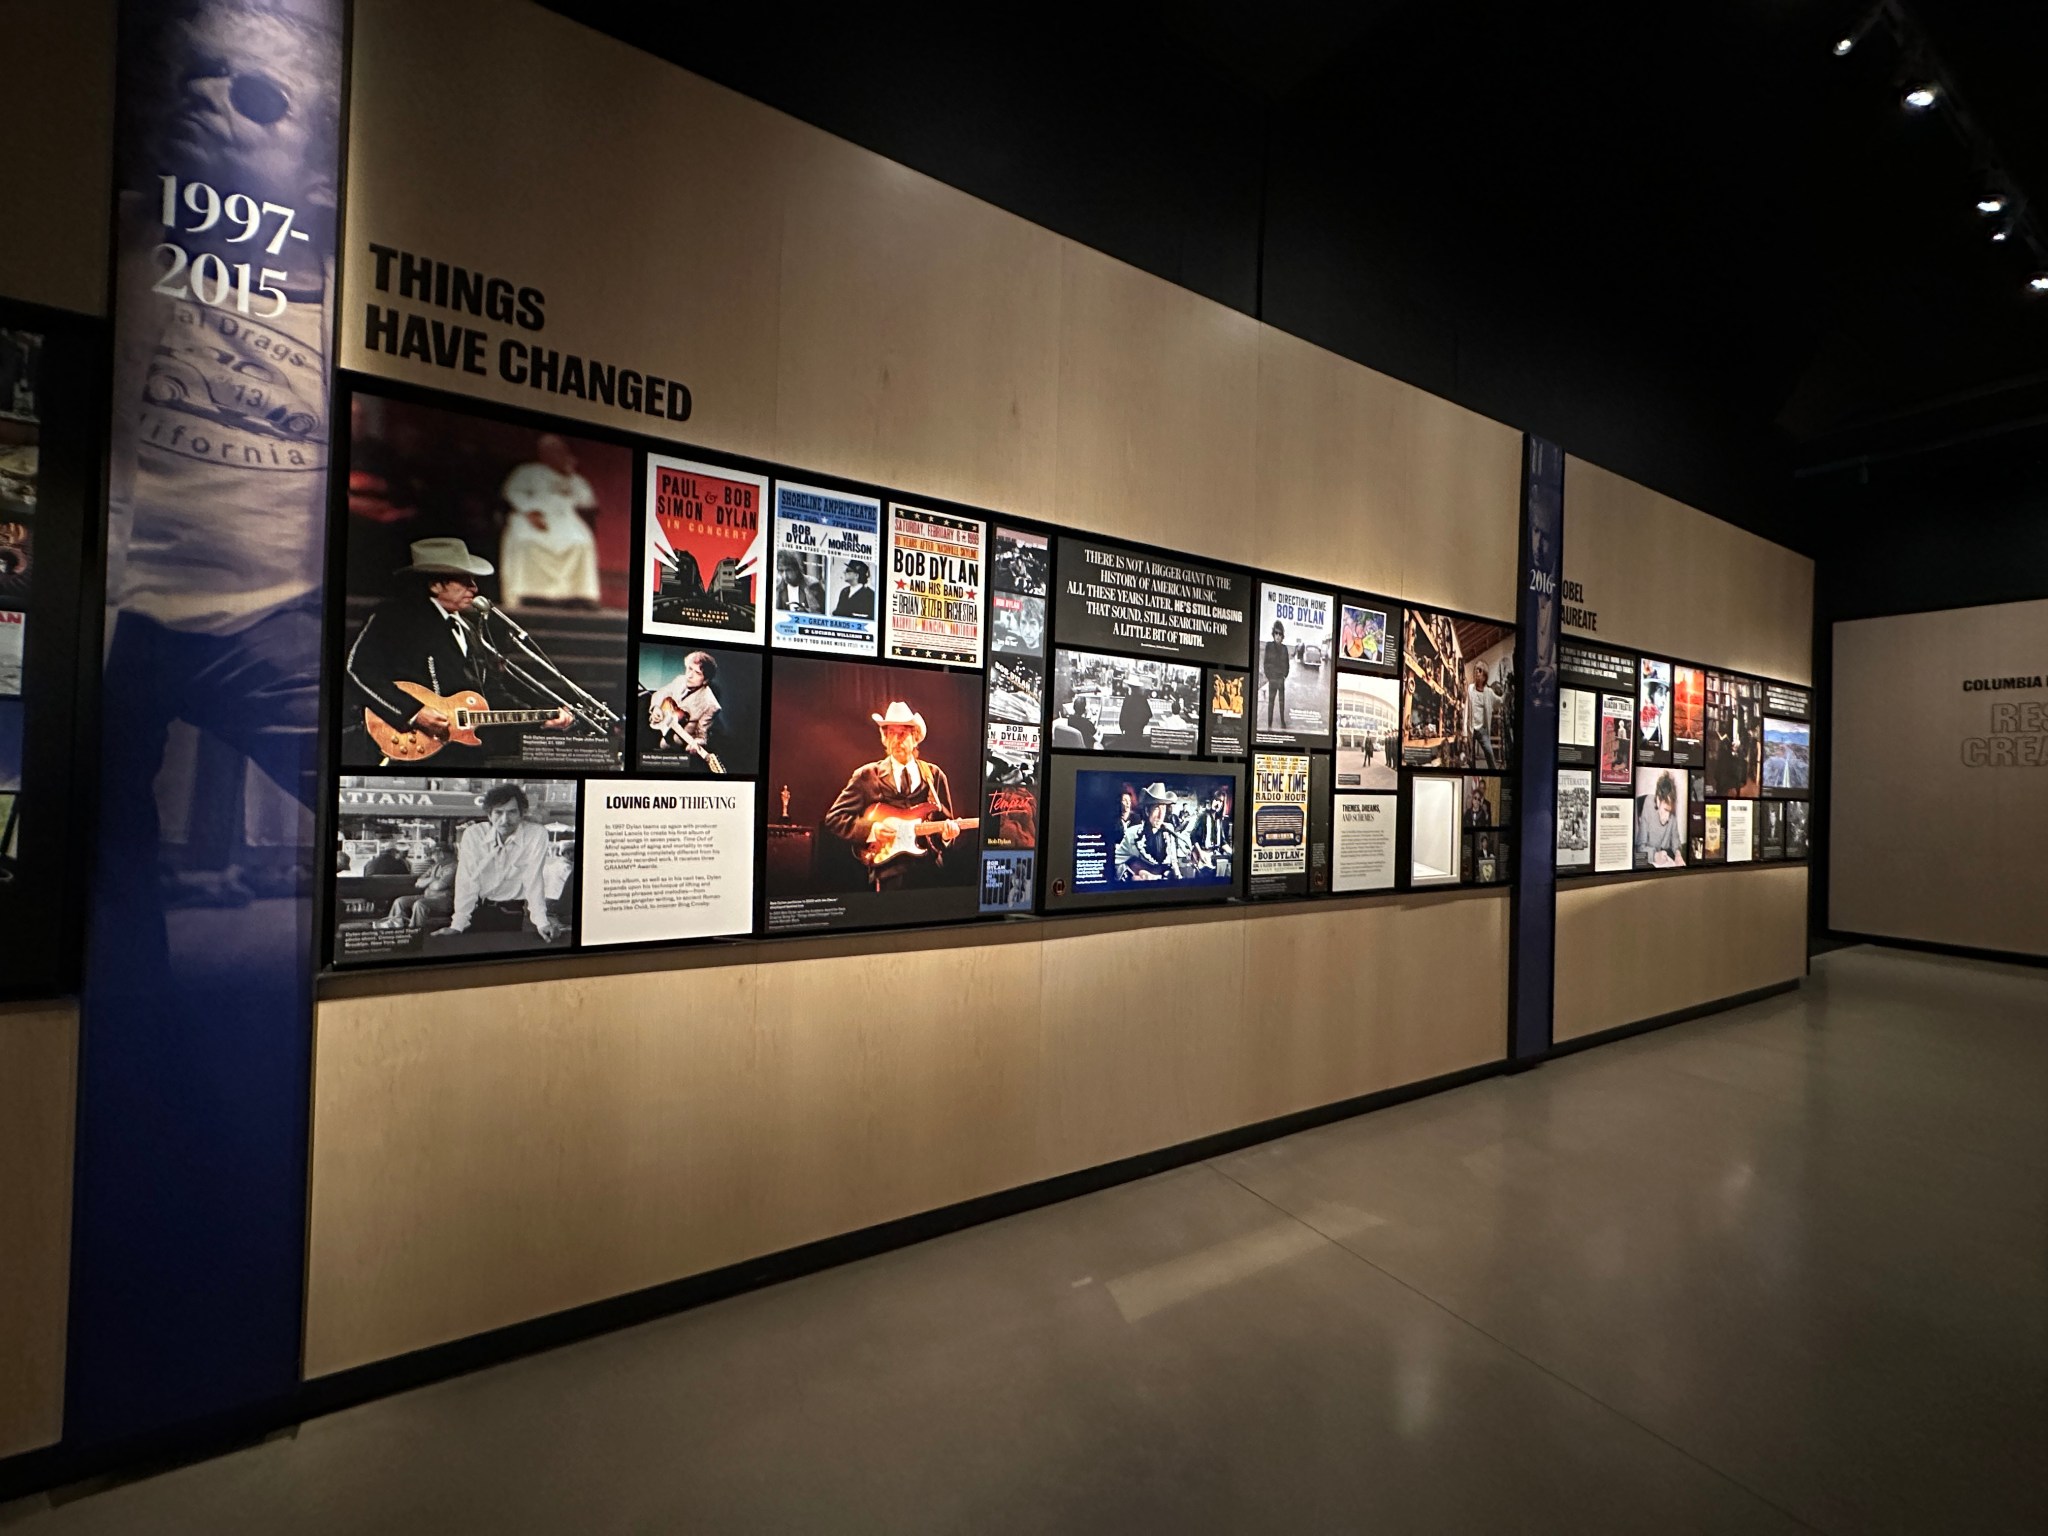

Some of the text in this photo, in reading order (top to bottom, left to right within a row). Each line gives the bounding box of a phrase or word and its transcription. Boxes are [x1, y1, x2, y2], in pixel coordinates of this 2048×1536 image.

[157, 175, 309, 255] 1997-
[152, 243, 288, 318] 2015
[369, 243, 546, 332] THINGS
[219, 316, 307, 366] Drags
[365, 303, 693, 422] HAVE CHANGED
[662, 474, 700, 500] PAUL
[724, 486, 752, 509] BOB
[657, 495, 758, 531] SIMON DYLAN
[781, 490, 877, 521] SHORELINE AMPHITHEATRE
[666, 519, 748, 540] IN CONCERT
[791, 523, 859, 543] BOB VAN
[894, 518, 926, 537] SATURDAY,
[927, 525, 954, 541] FEBRUARY
[786, 532, 872, 555] DYLAN MORRISON
[920, 540, 934, 551] AFTER
[893, 547, 979, 587] BOB DYLAN
[1084, 548, 1231, 590] THERE IS NOT A BIGGER GIANT IN THE
[909, 579, 964, 599] AND HIS BAND
[1100, 569, 1217, 603] HISTORY OF AMERICAN MUSIC.
[1529, 568, 1556, 594] 2016-
[1562, 580, 1584, 603] OBEL
[898, 594, 919, 615] BRIAN
[920, 597, 943, 619] SETZER
[944, 601, 978, 623] ORCHESTRA
[1066, 580, 1086, 596] ALL
[1086, 583, 1116, 601] THESE
[1117, 589, 1144, 606] YEARS
[1174, 599, 1192, 614] HE'S
[1192, 602, 1211, 617] STILL
[1212, 606, 1243, 623] CHASING
[1268, 591, 1327, 611] NO DIRECTION HOME
[794, 616, 800, 624] 2
[808, 618, 828, 627] GREAT
[830, 621, 850, 629] BANDS
[1086, 600, 1228, 636] THAT SOUND, STILL SEARCHING FOR
[1276, 603, 1324, 625] BOB DYLAN
[1560, 605, 1597, 631] AUREATE
[793, 636, 808, 644] DON'T
[1112, 622, 1119, 635] A
[1120, 623, 1151, 640] LITTLE
[1152, 626, 1166, 641] BIT
[1167, 630, 1178, 643] OF
[1178, 631, 1205, 647] TRUTH.
[1963, 676, 2042, 692] COLUMBIA
[1001, 732, 1028, 742] DYLAN
[1006, 725, 1024, 733] BOB
[1256, 772, 1307, 792] THEME TIME
[606, 796, 736, 809] LOVING AND THIEVING
[989, 790, 1035, 816] Tempest
[1256, 792, 1306, 801] RADIO HOUR
[1258, 851, 1300, 860] BOB DYLAN
